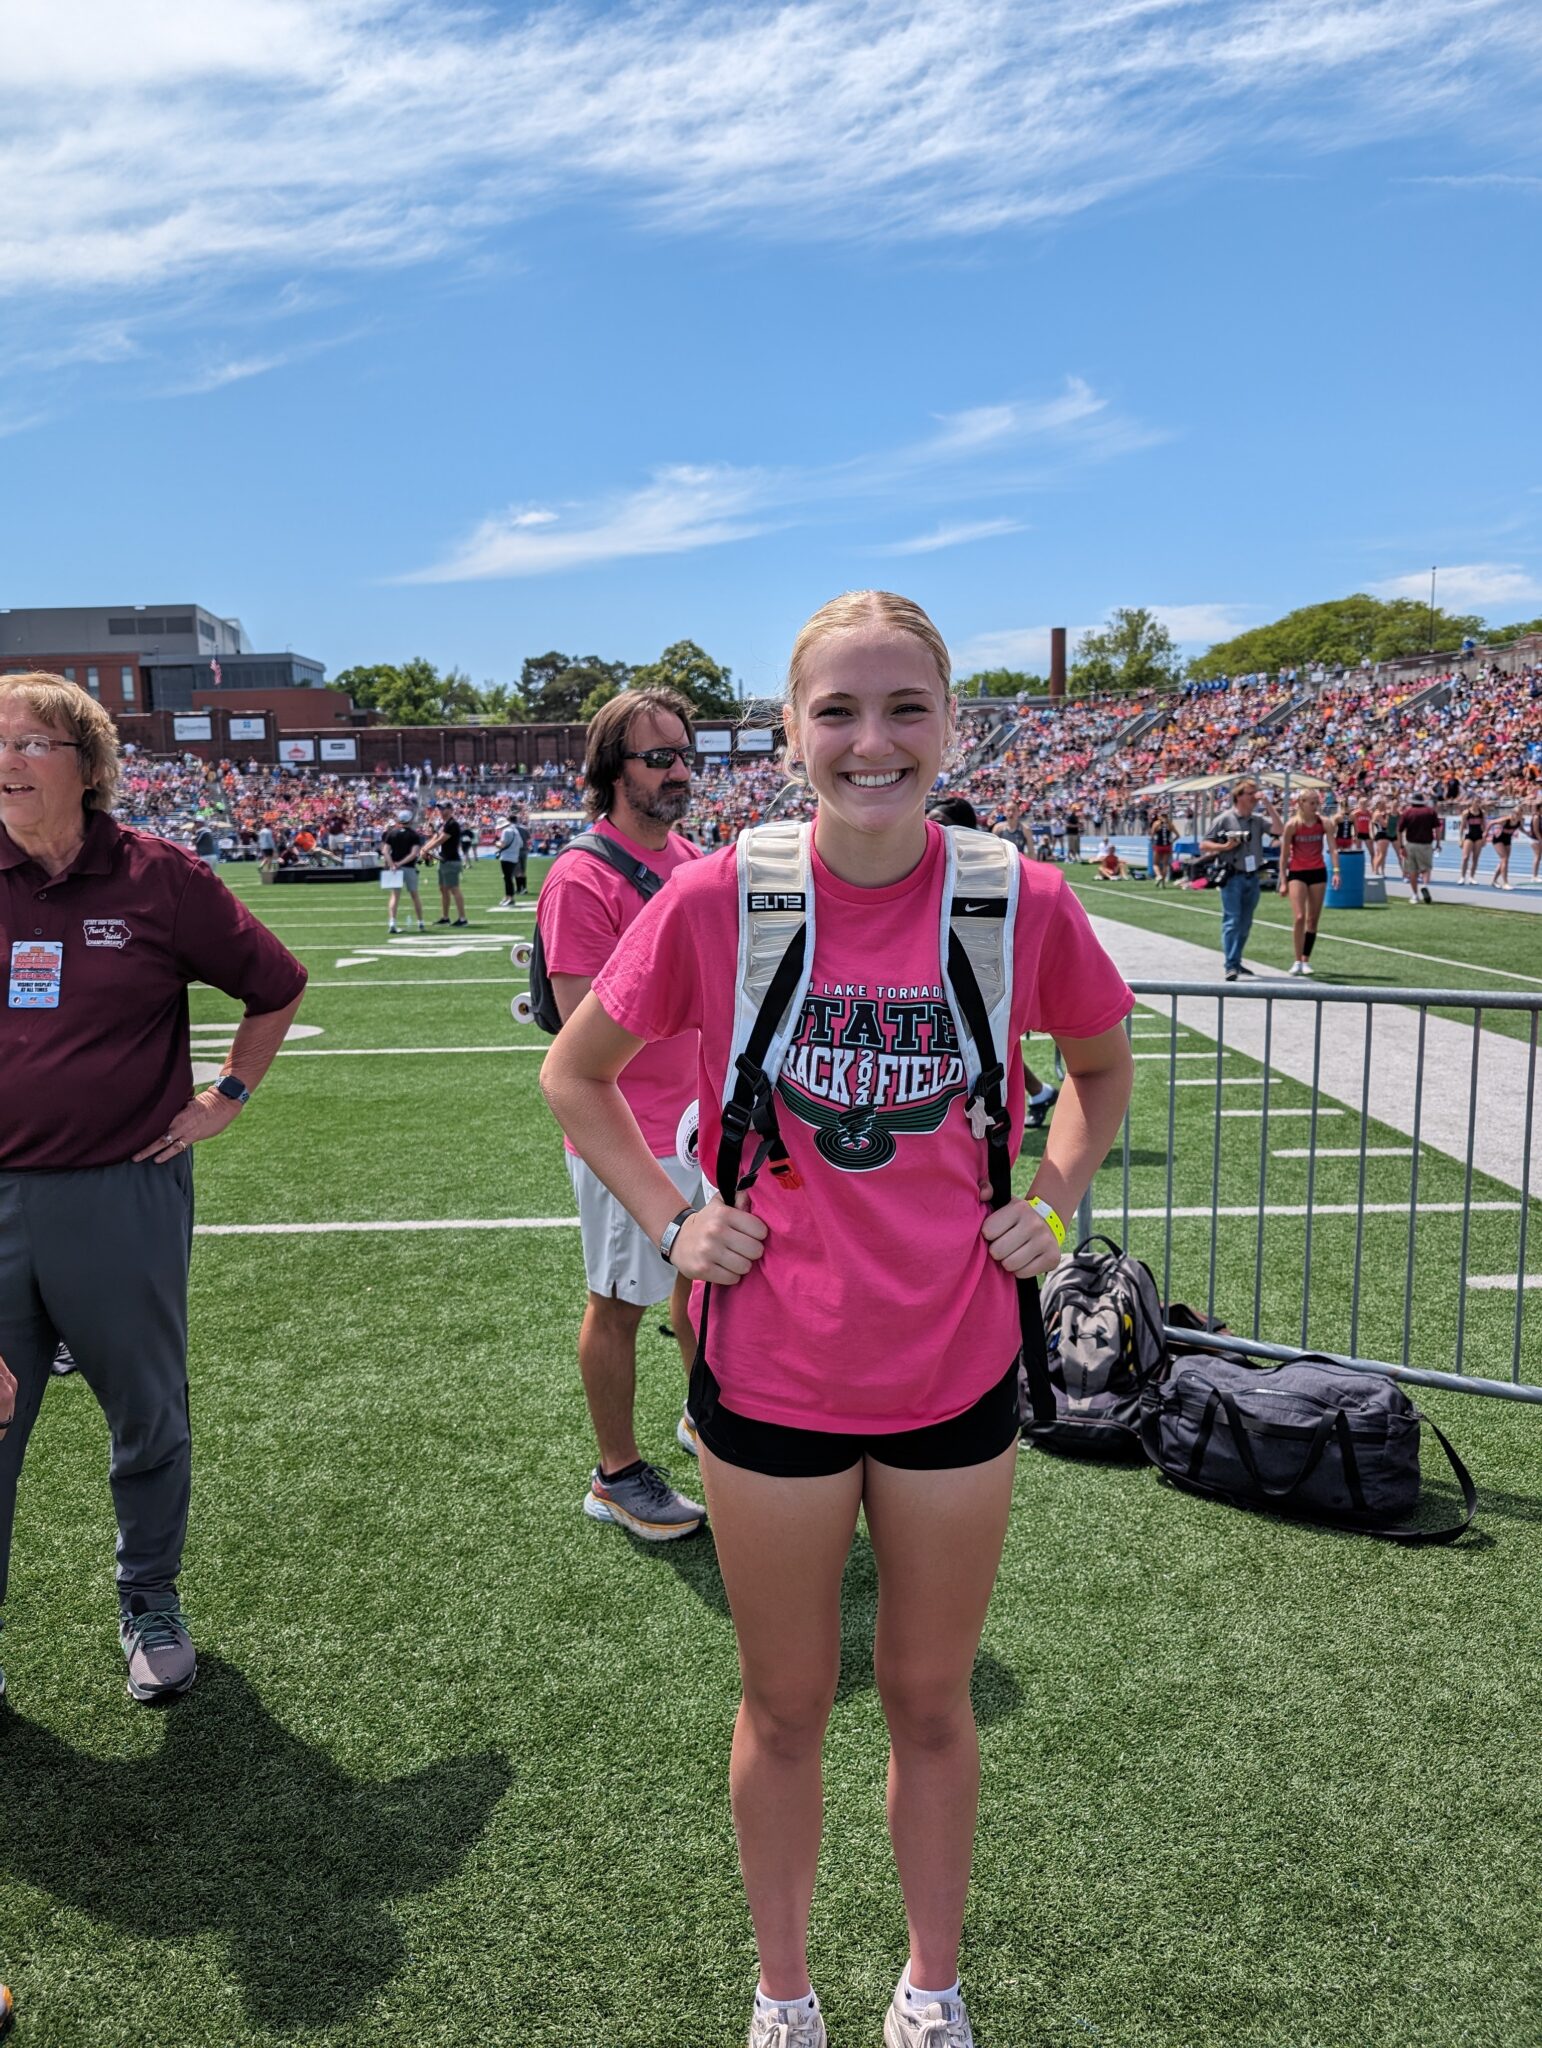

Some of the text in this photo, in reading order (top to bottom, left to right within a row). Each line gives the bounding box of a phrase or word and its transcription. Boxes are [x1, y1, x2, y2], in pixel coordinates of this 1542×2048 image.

[752, 895, 802, 909] ELITE
[87, 926, 106, 935] Track
[103, 932, 122, 941] Field
[824, 983, 867, 997] LAKE
[855, 1049, 875, 1106] 2024
[873, 1054, 965, 1106] FIELD
